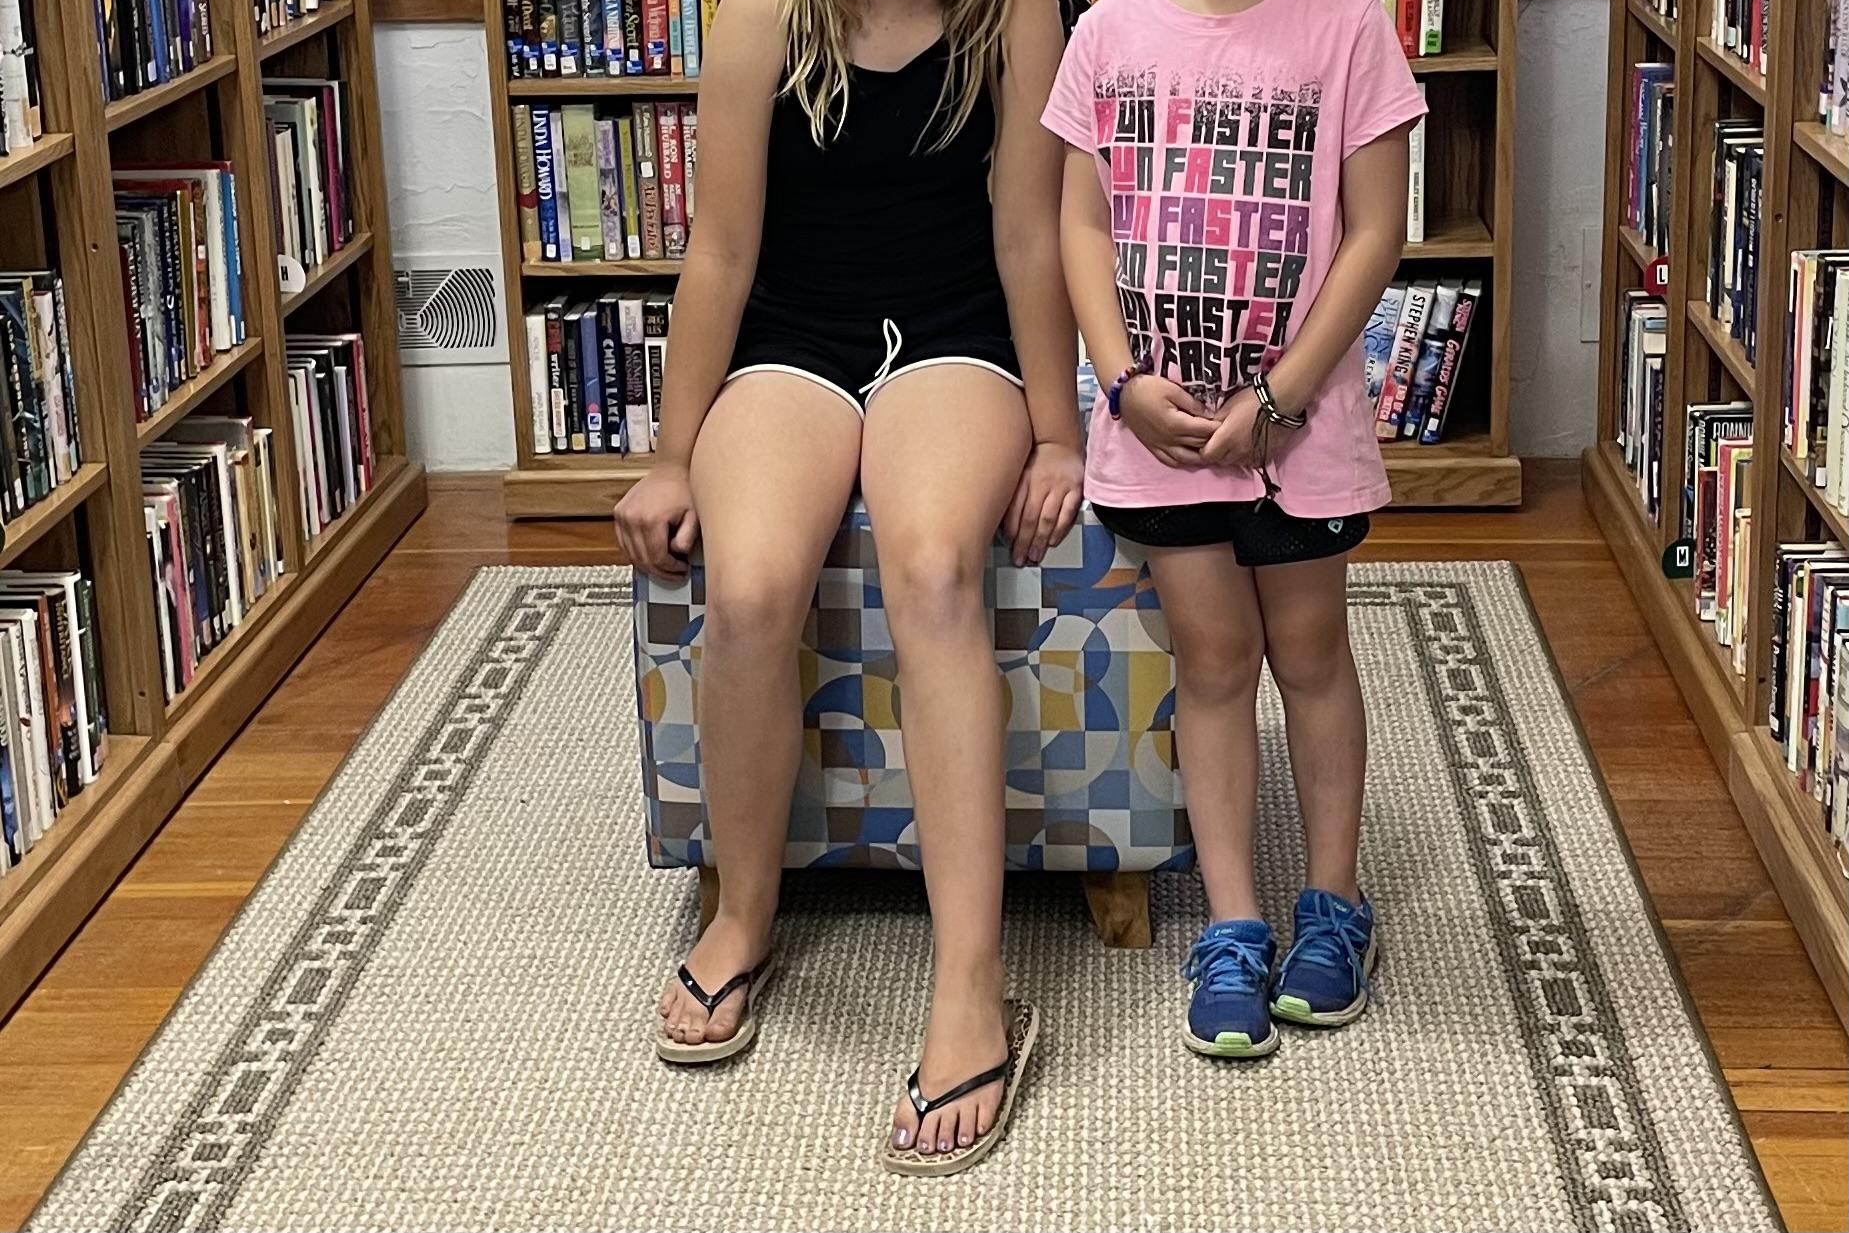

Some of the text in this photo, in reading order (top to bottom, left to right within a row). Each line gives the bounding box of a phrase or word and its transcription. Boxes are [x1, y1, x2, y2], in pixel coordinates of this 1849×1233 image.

[624, 13, 640, 47] Secret
[648, 6, 666, 38] Victoria
[1094, 98, 1319, 151] RUN FASTER
[515, 112, 532, 191] LINDA HOWARD
[533, 110, 553, 200] LINDA HOWARD
[662, 126, 671, 179] HUBBARD
[684, 125, 693, 178] HUBBARD
[1098, 146, 1314, 201] UN FASTER
[1113, 194, 1311, 255] UN FASTER
[1156, 244, 1307, 299] FASTER
[1660, 268, 1665, 282] L
[1155, 292, 1294, 348] FASTER
[1378, 299, 1400, 354] STEPHEN
[1395, 294, 1426, 374] STEPHEN KING
[1452, 303, 1462, 326] KING
[1456, 299, 1472, 333] STEPHEN
[603, 338, 619, 423] CHINA LAKE
[632, 350, 643, 397] GENGHIS
[1392, 385, 1408, 414] END OF
